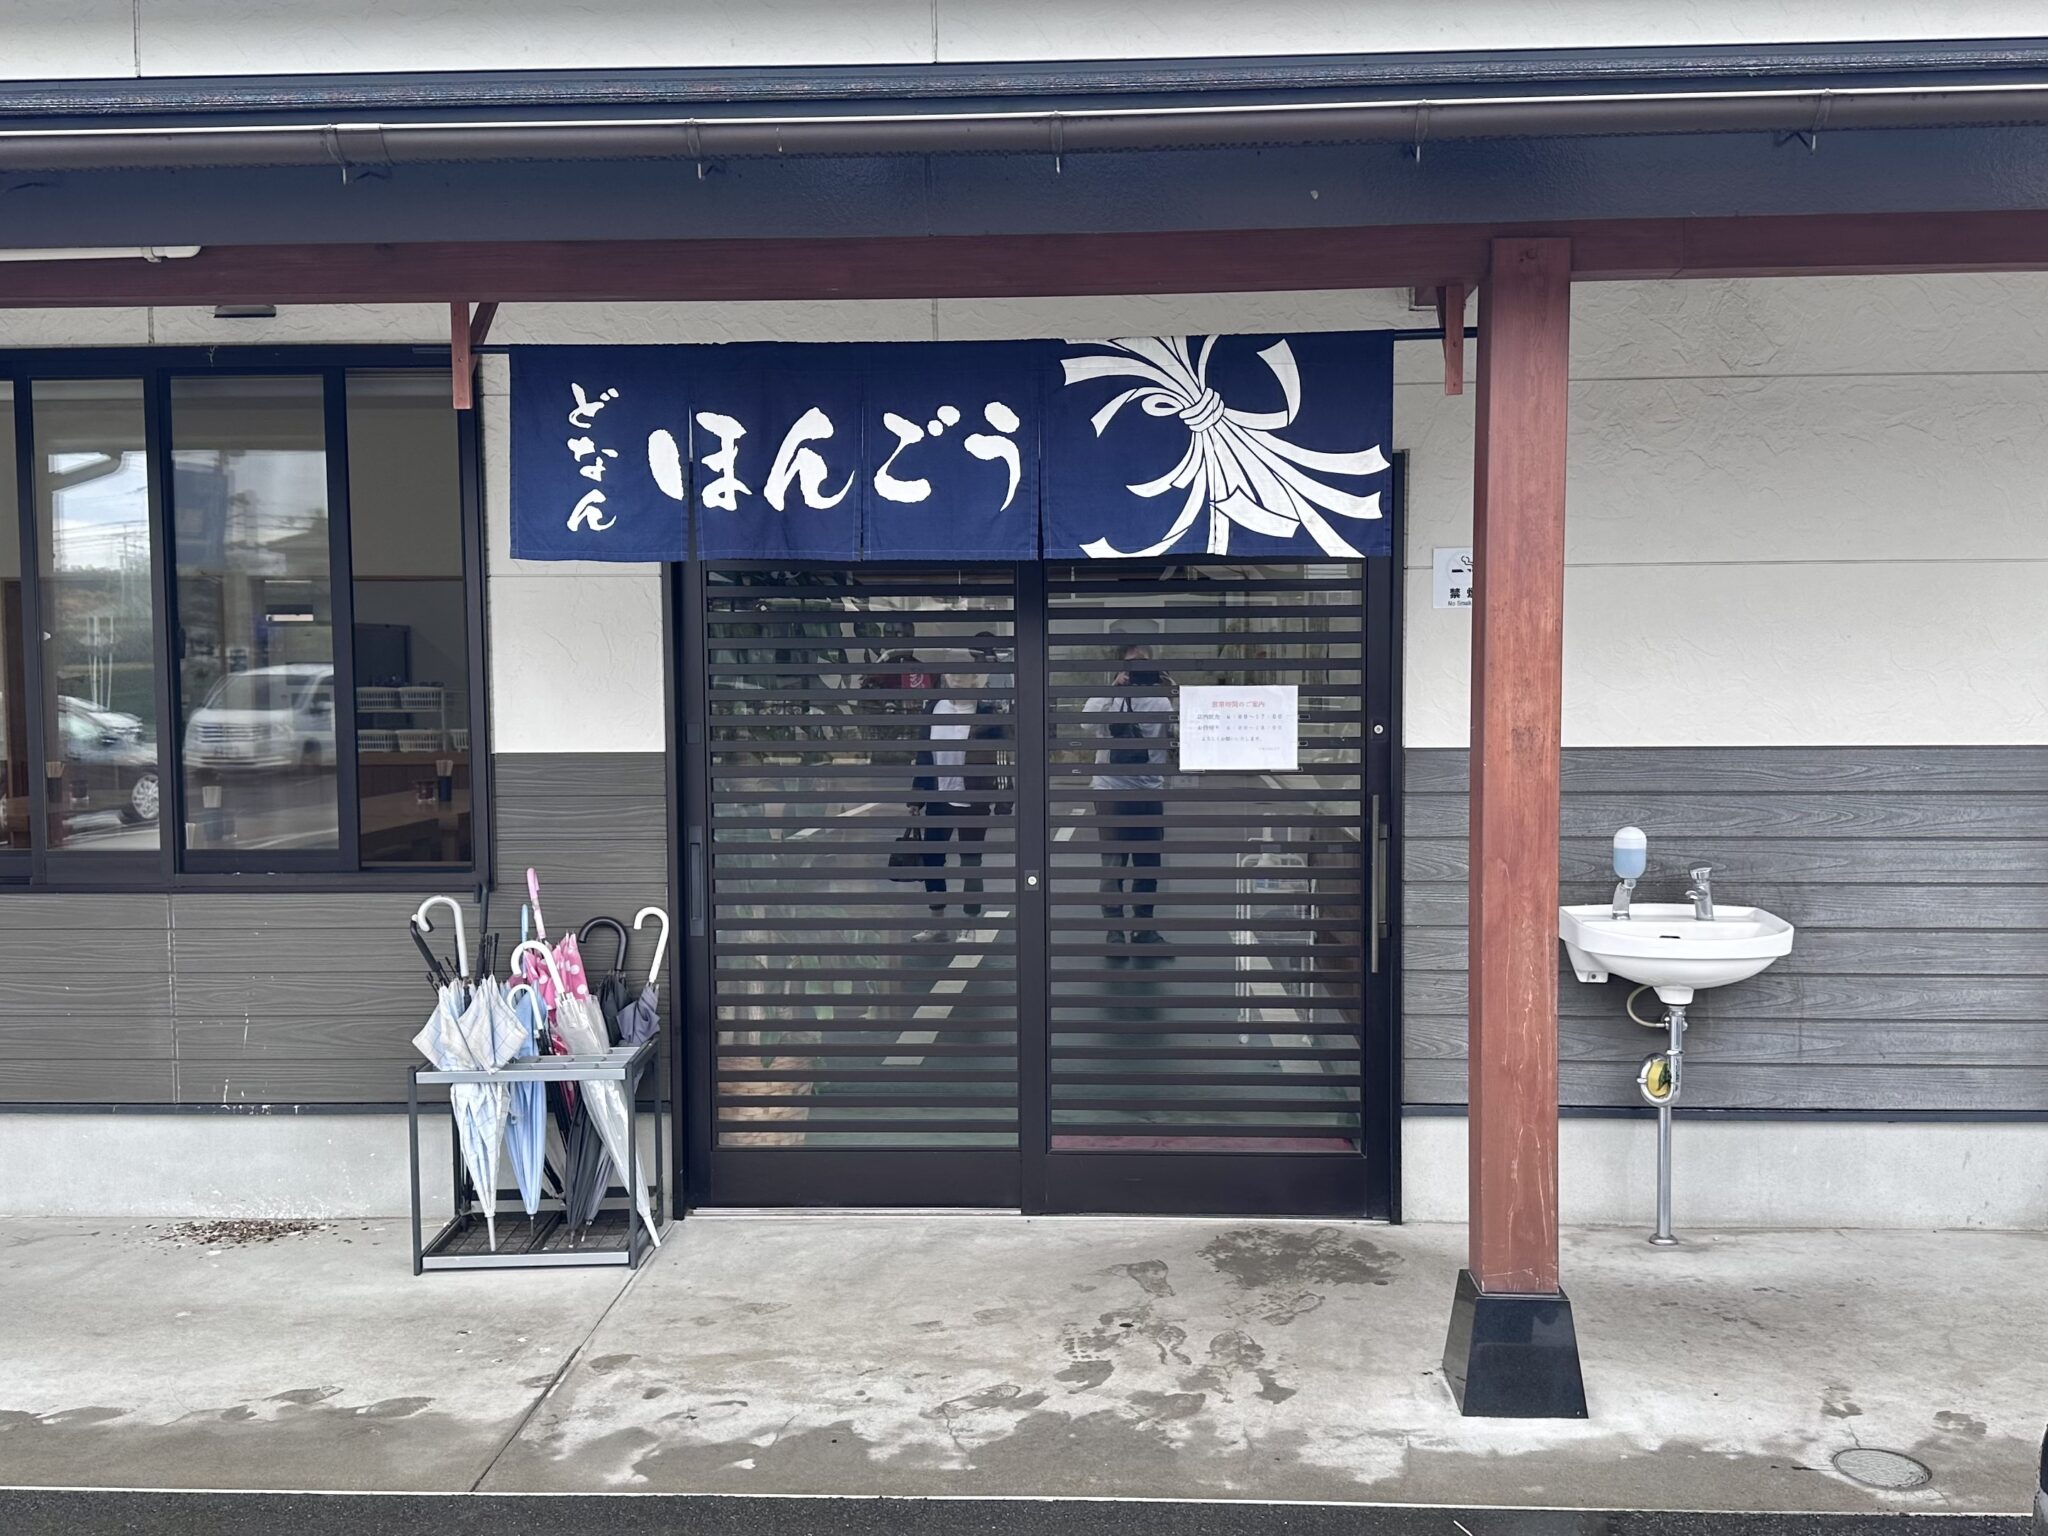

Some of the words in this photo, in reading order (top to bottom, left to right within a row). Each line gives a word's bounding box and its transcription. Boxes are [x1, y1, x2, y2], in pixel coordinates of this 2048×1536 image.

[567, 382, 619, 532] どなん
[648, 401, 1021, 512] ほんごう
